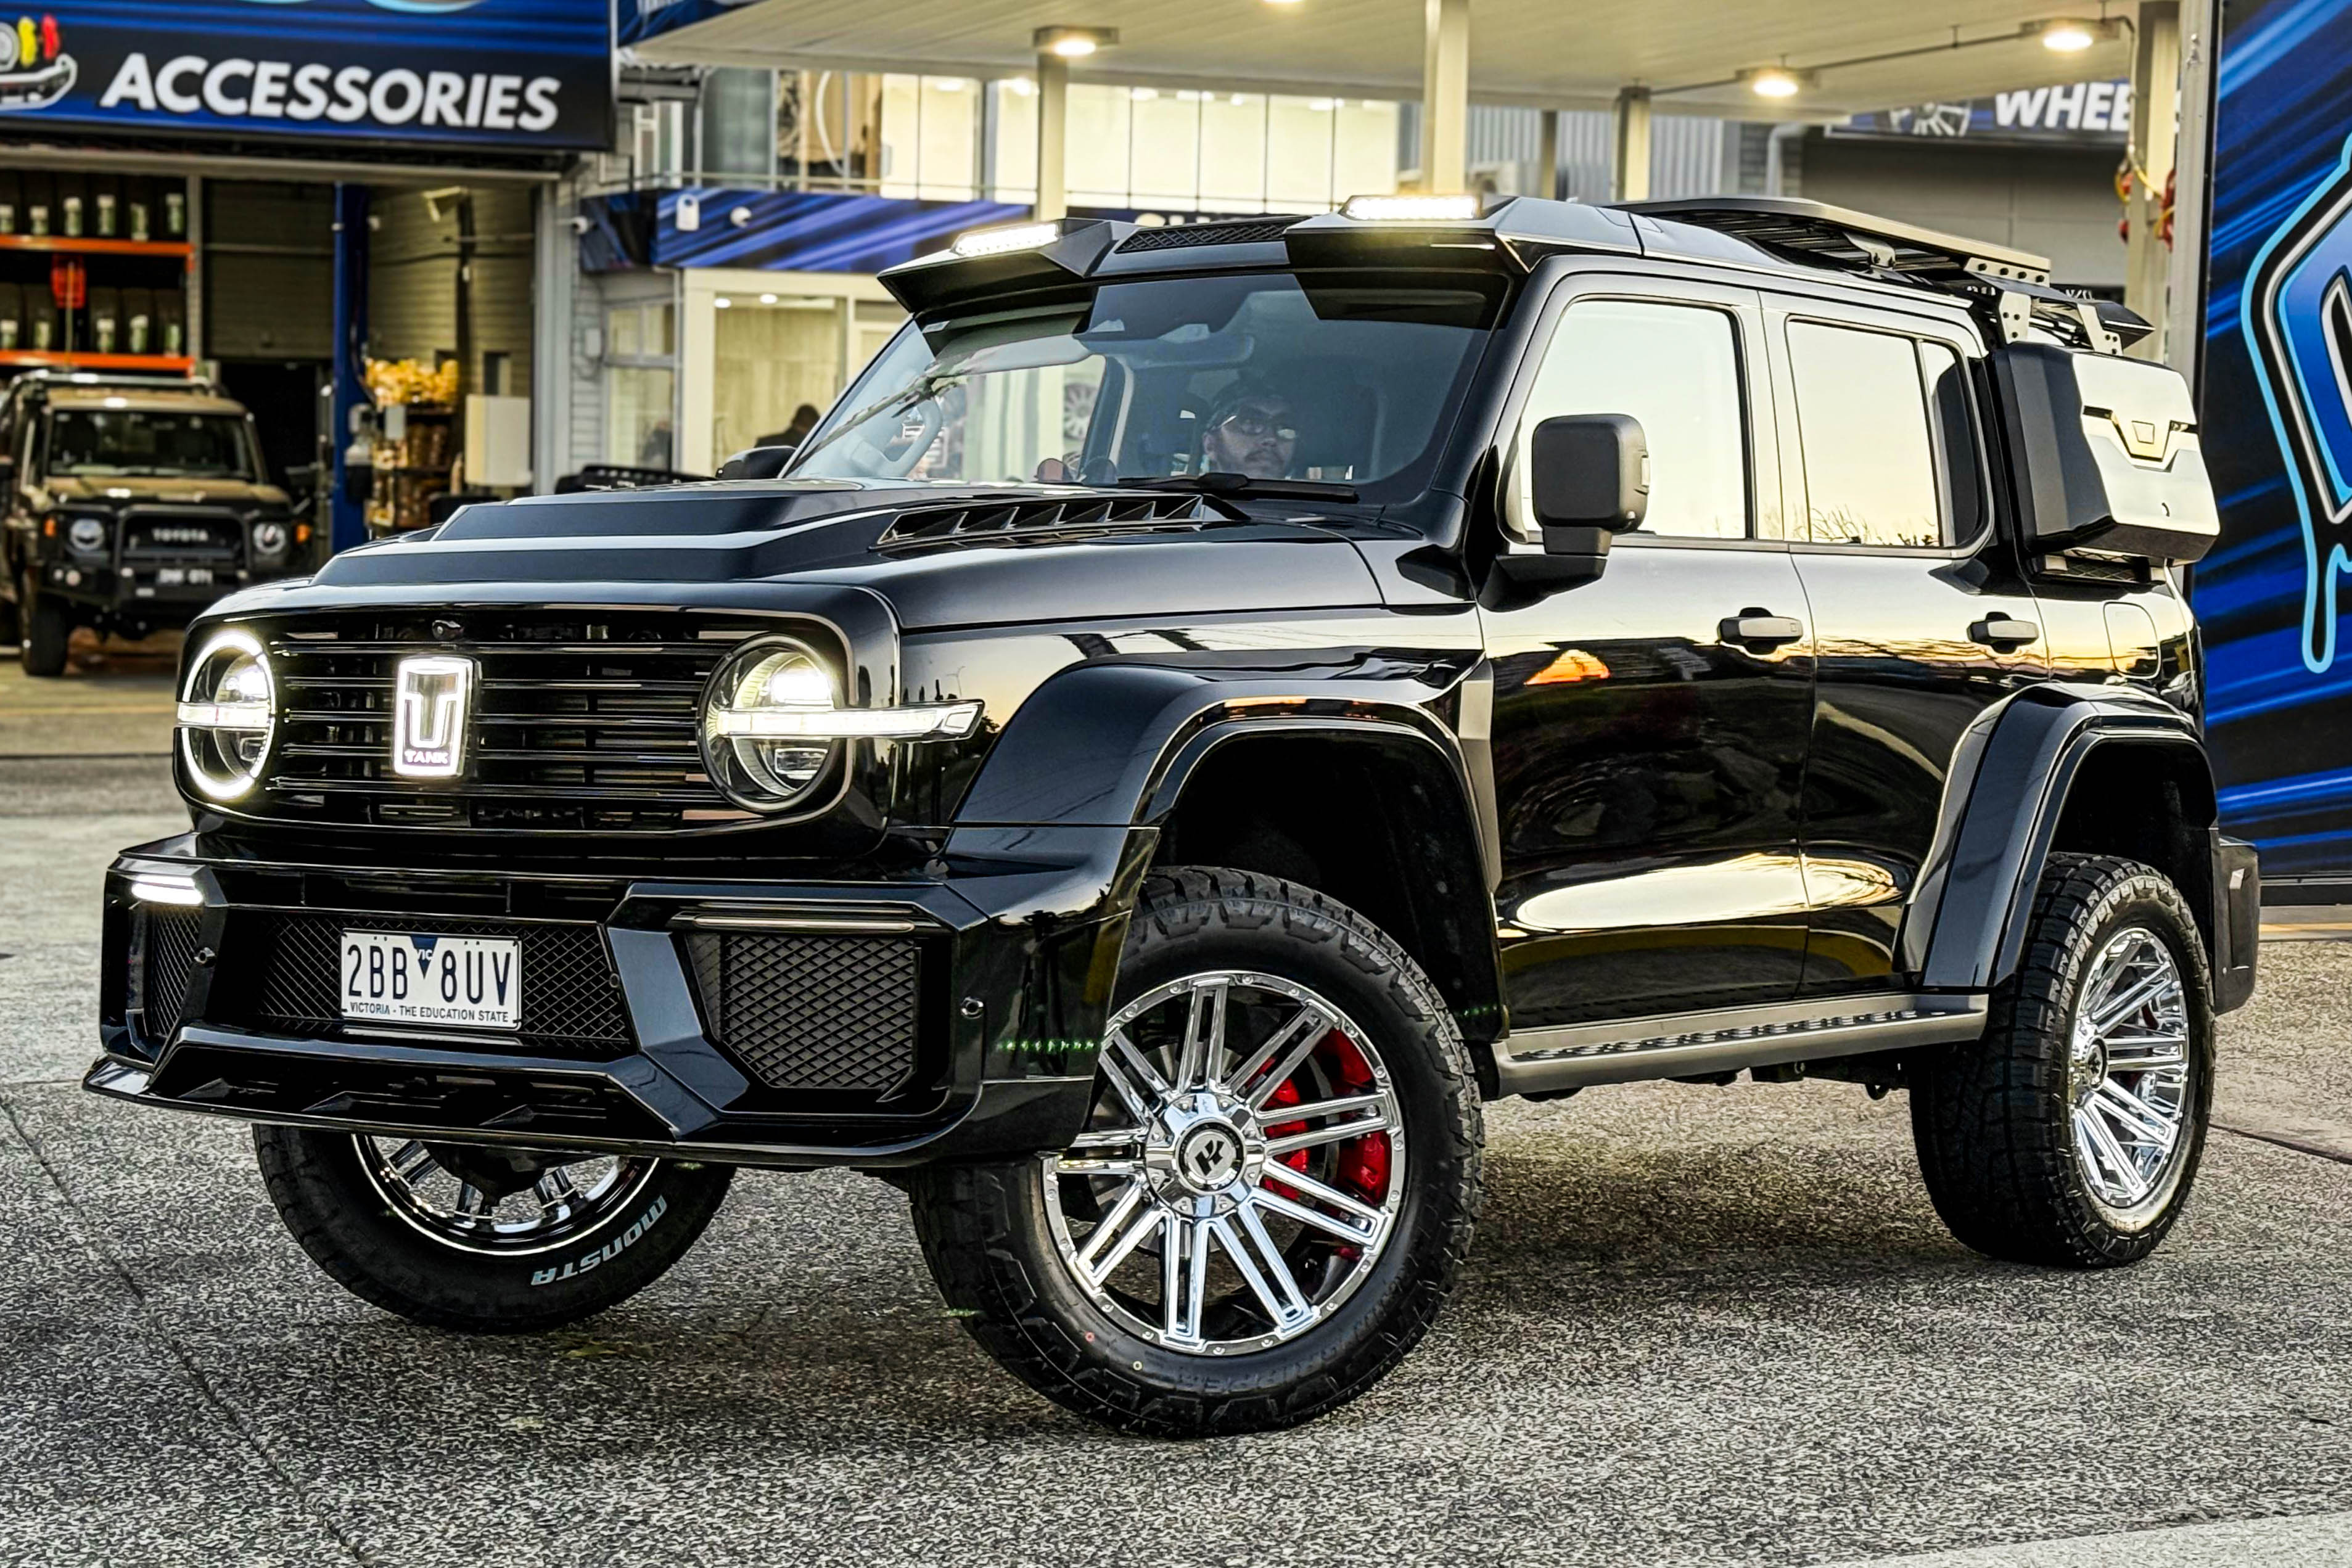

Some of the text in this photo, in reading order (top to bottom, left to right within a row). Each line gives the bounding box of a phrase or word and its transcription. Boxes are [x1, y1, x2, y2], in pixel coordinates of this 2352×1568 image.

[100, 53, 561, 131] ACCESSORIES
[1996, 81, 2182, 131] WHEE
[405, 749, 448, 764] TANK
[347, 945, 511, 1006] 2BB 8UV
[350, 1002, 390, 1014] VICTORIA
[400, 1006, 417, 1017] THE
[420, 1007, 474, 1020] EDUCATION
[479, 1011, 509, 1022] STATE
[531, 1194, 668, 1286] MONSTA
